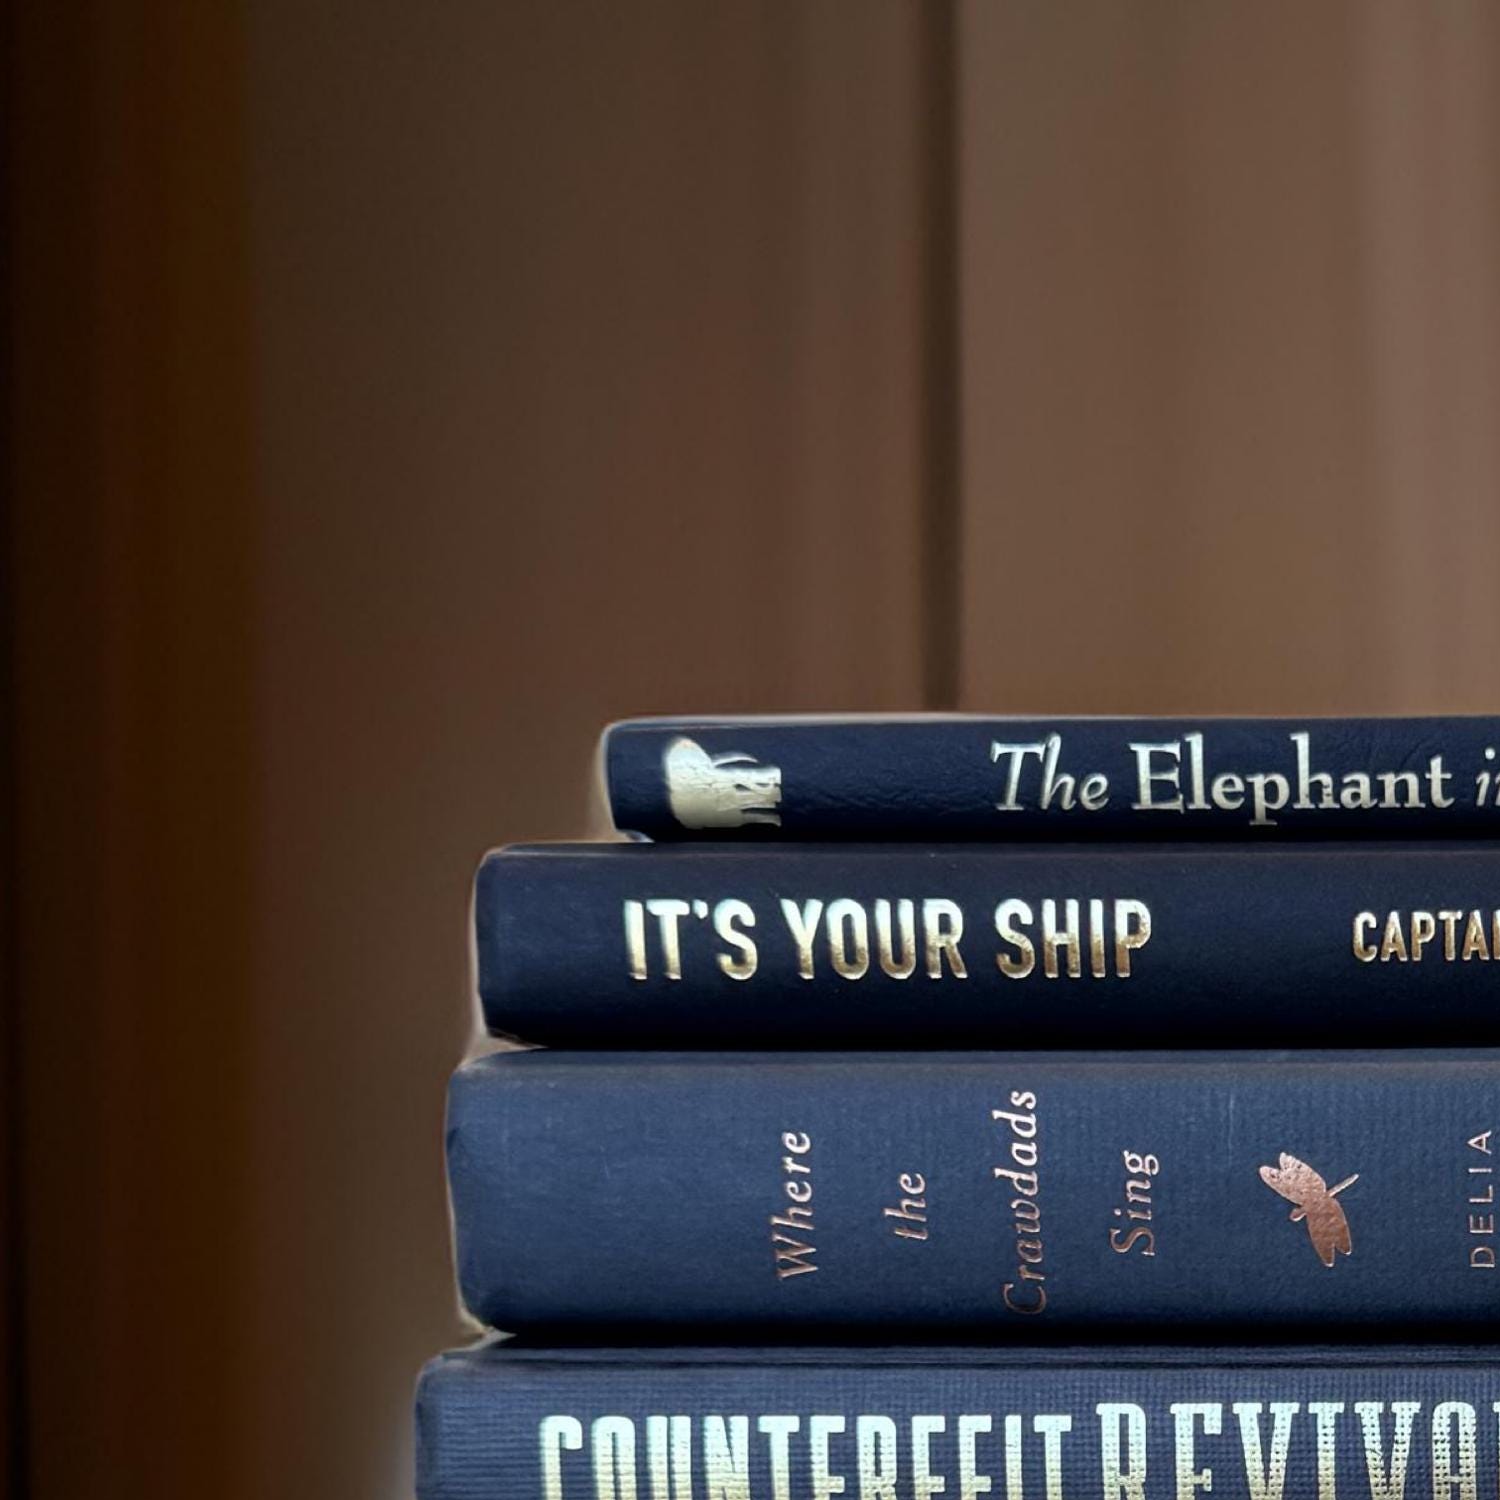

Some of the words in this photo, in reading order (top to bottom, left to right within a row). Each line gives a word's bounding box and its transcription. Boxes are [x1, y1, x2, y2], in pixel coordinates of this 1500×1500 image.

[989, 732, 1110, 813] The
[1128, 731, 1454, 826] Elephant
[623, 898, 758, 981] IT'S
[780, 898, 968, 981] YOUR
[995, 897, 1153, 981] SHIP
[772, 1130, 819, 1282] Where
[882, 1171, 929, 1242] the
[992, 1089, 1047, 1316] Crawdads
[1110, 1149, 1160, 1257] Sing
[1468, 1129, 1497, 1270] DELIA
